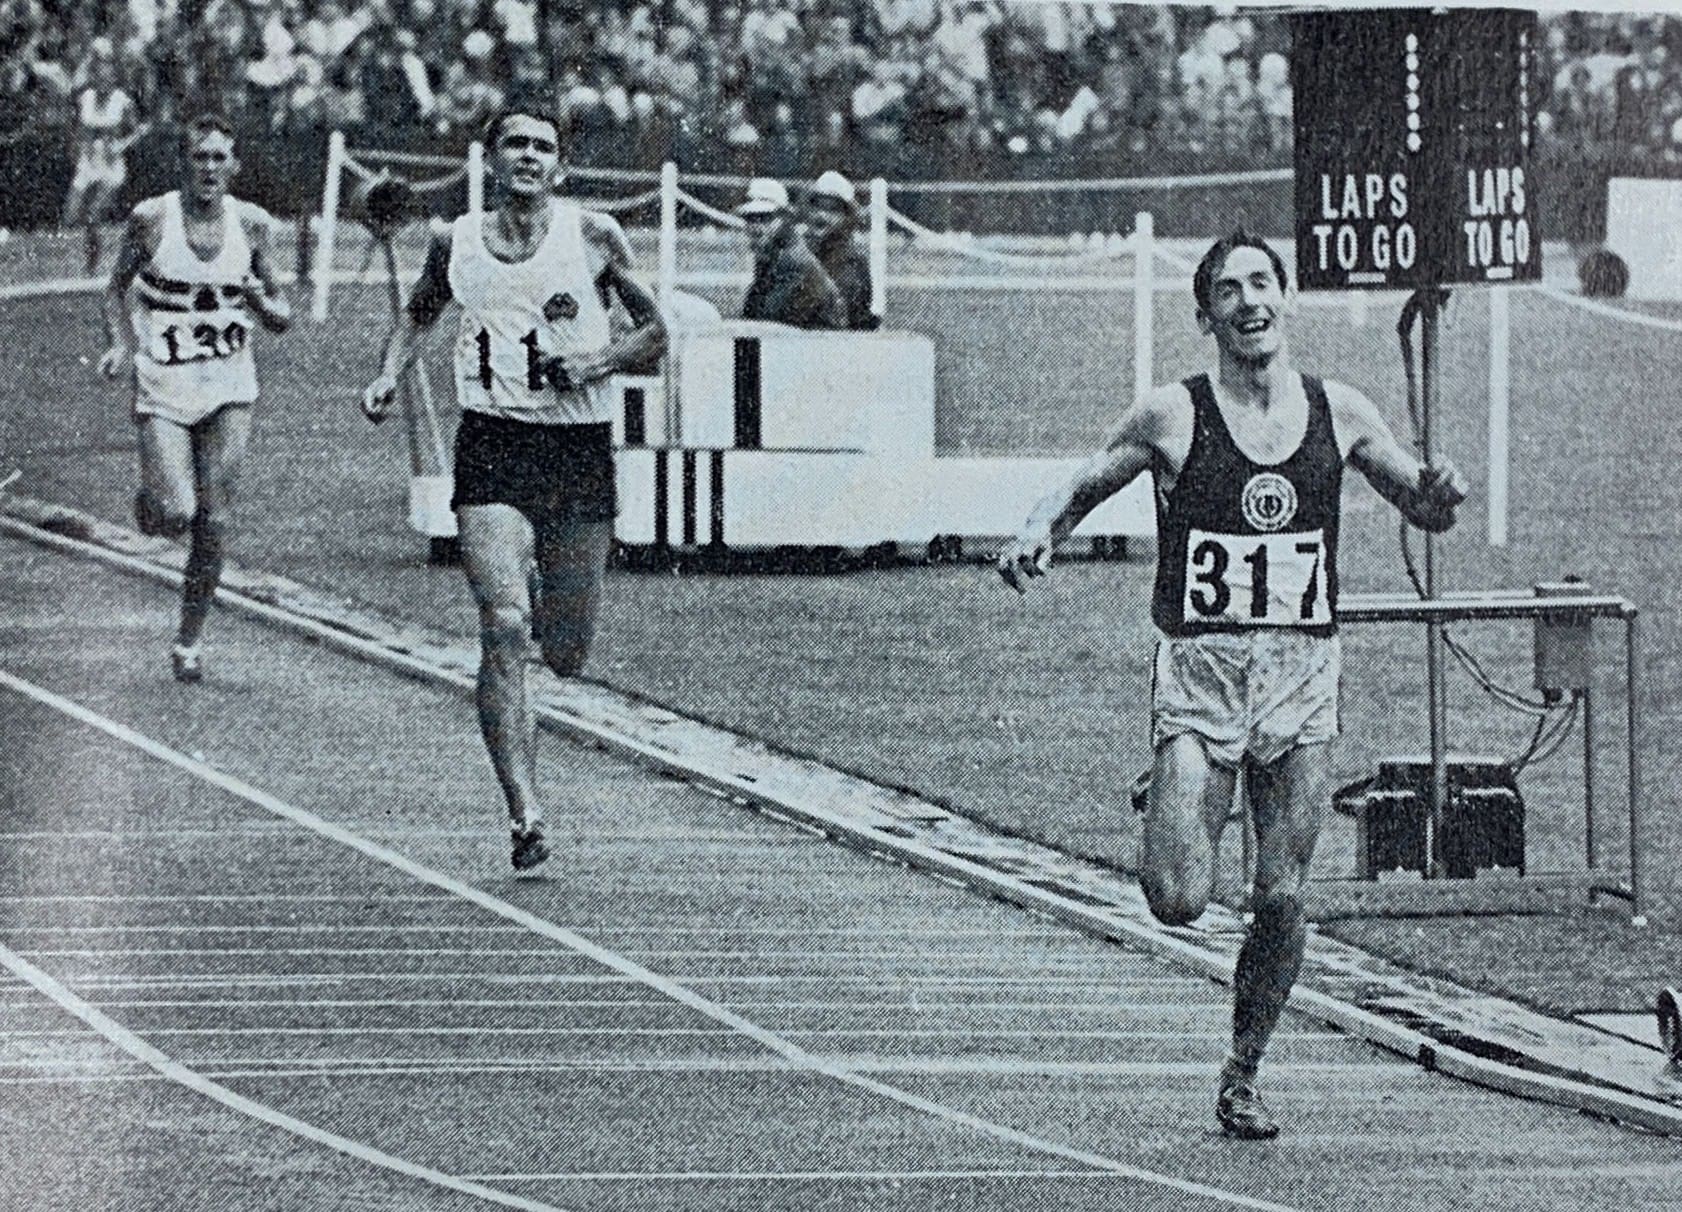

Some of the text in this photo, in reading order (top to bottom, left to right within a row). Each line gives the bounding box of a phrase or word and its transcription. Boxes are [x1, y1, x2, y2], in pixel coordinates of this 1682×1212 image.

[1321, 173, 1408, 220] LAPS
[1467, 166, 1526, 217] LAPS
[1313, 223, 1416, 270] TO GO
[1463, 218, 1530, 267] TO GO
[1190, 540, 1319, 619] 317
